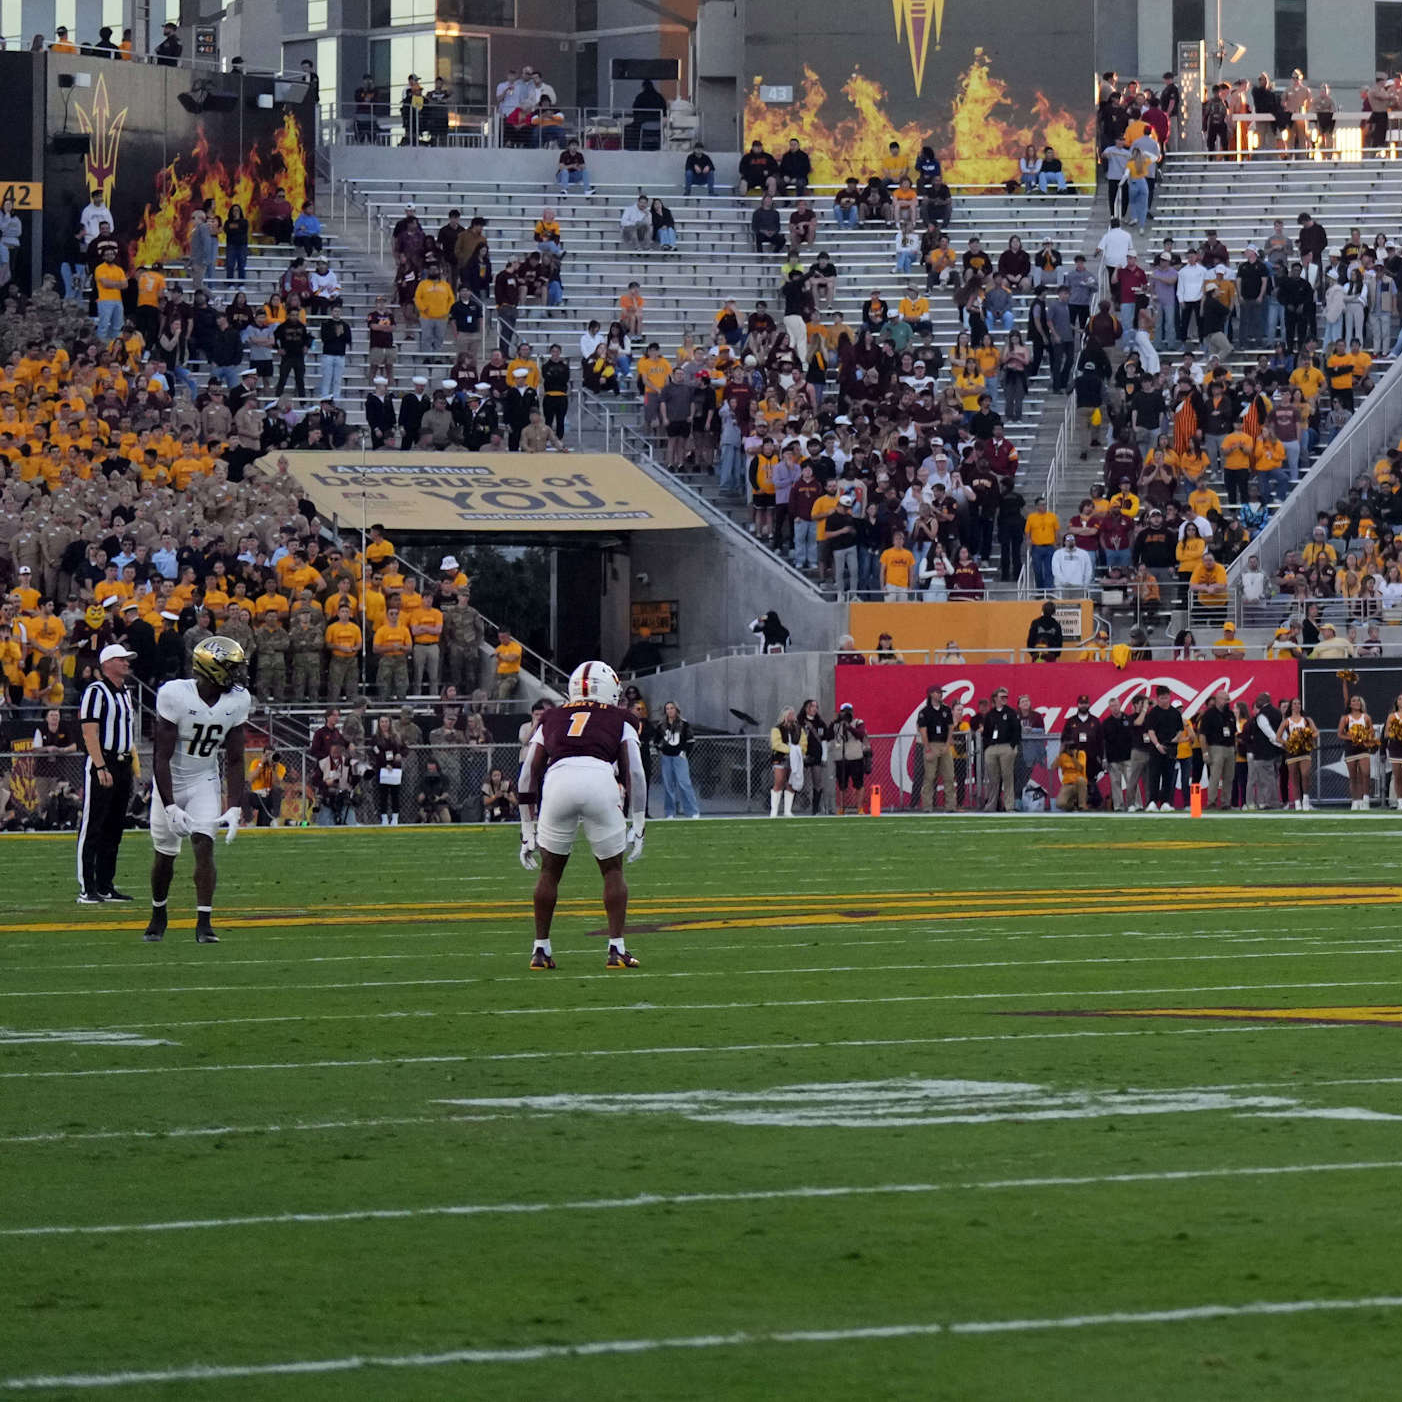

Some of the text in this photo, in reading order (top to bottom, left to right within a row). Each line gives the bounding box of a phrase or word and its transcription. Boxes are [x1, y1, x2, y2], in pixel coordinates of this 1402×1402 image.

[767, 87, 788, 101] 43
[311, 473, 598, 489] because of
[423, 491, 630, 512] YOU.
[567, 712, 591, 737] 1
[187, 723, 223, 758] 16
